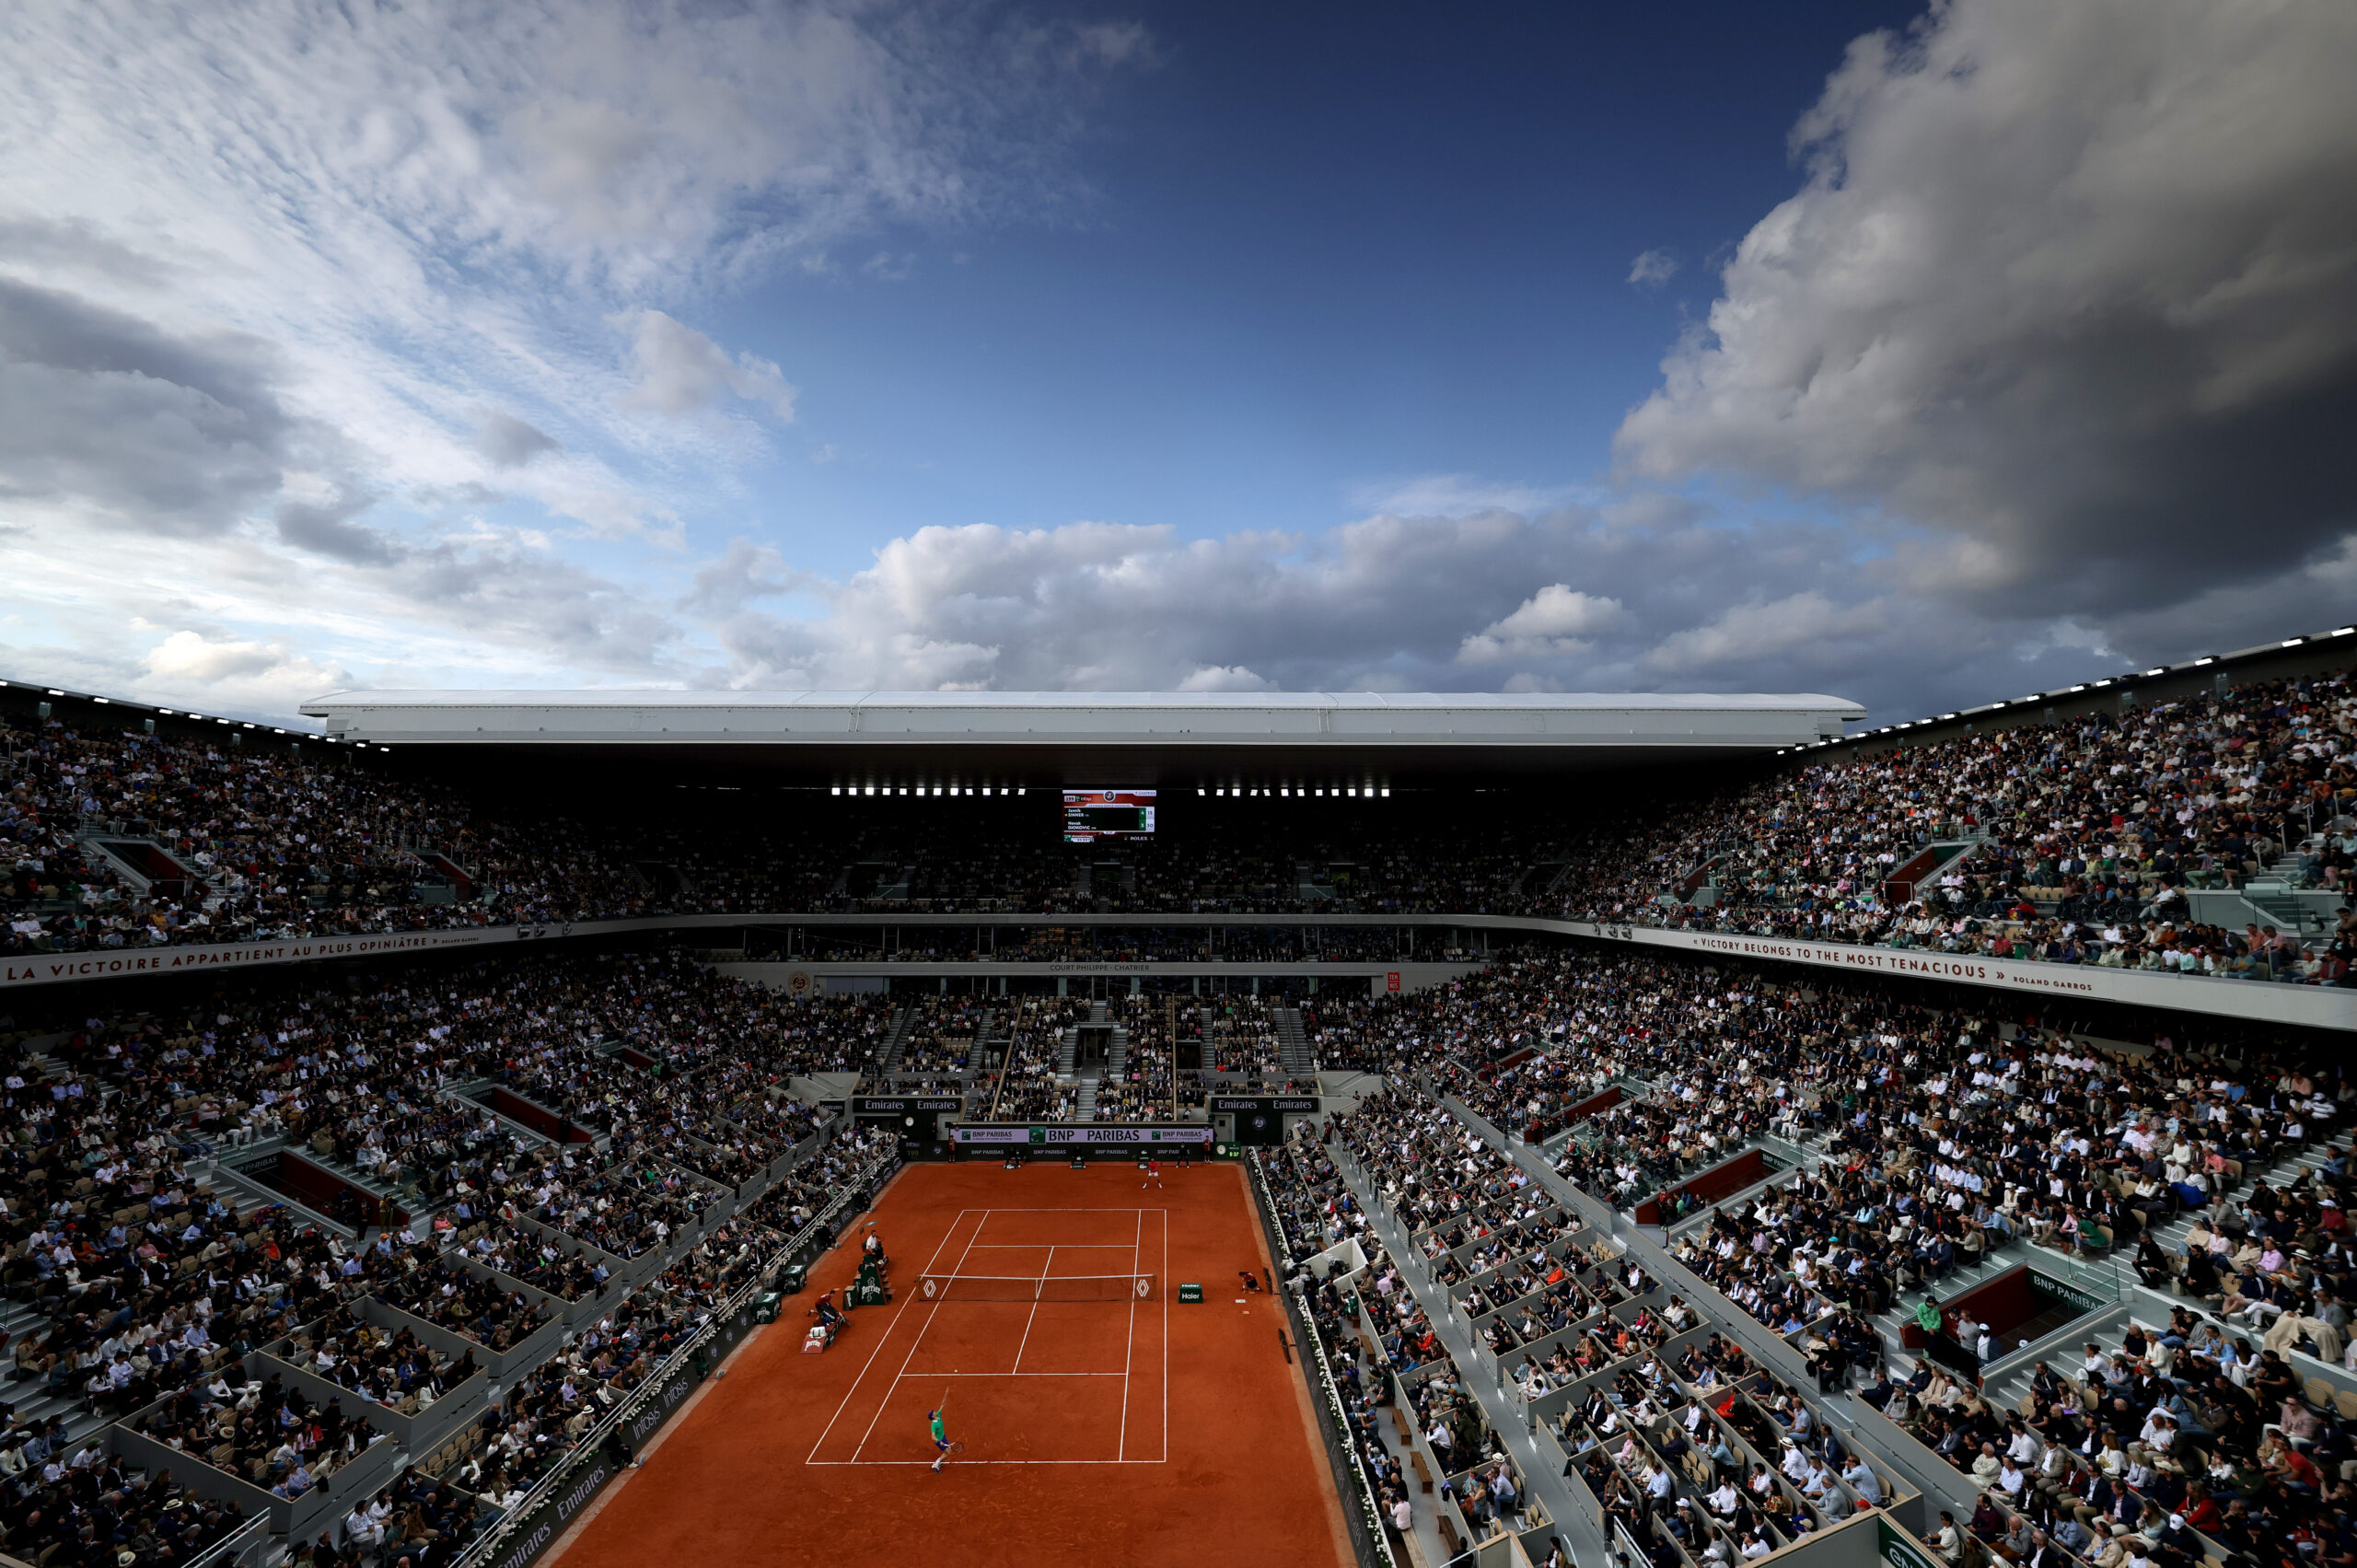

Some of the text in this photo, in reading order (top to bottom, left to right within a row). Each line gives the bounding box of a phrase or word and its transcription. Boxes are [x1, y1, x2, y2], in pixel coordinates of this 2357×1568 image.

[7, 968, 35, 981] LA
[51, 958, 160, 976] VICTOIRE
[172, 942, 285, 966] APPARTIENT
[292, 946, 311, 957] AU
[319, 943, 352, 954] PLUS
[1701, 937, 1740, 951] VICTORY
[1745, 943, 1791, 957] BELONGS
[1797, 948, 1810, 958] TO
[1817, 950, 1840, 962] THE
[1846, 954, 1882, 967] MOST
[1890, 958, 1986, 979] TENACIOUS
[2014, 976, 2092, 992] ROLAND GARROS
[865, 1099, 905, 1110] Emirates
[917, 1099, 957, 1110] Emirates
[1218, 1099, 1258, 1109] Emirates
[1273, 1099, 1312, 1109] Emirates
[1049, 1130, 1140, 1142] BNP PARIBAS
[1762, 1153, 1774, 1163] BNP
[2033, 1275, 2055, 1291] BNP
[862, 1285, 881, 1300] Perrier
[1182, 1292, 1200, 1300] Haier
[804, 1340, 821, 1353] Perrier
[662, 1376, 690, 1409] Infosys
[632, 1405, 661, 1441] Infosys
[556, 1465, 605, 1521] Emirates
[498, 1521, 552, 1568] mirates
